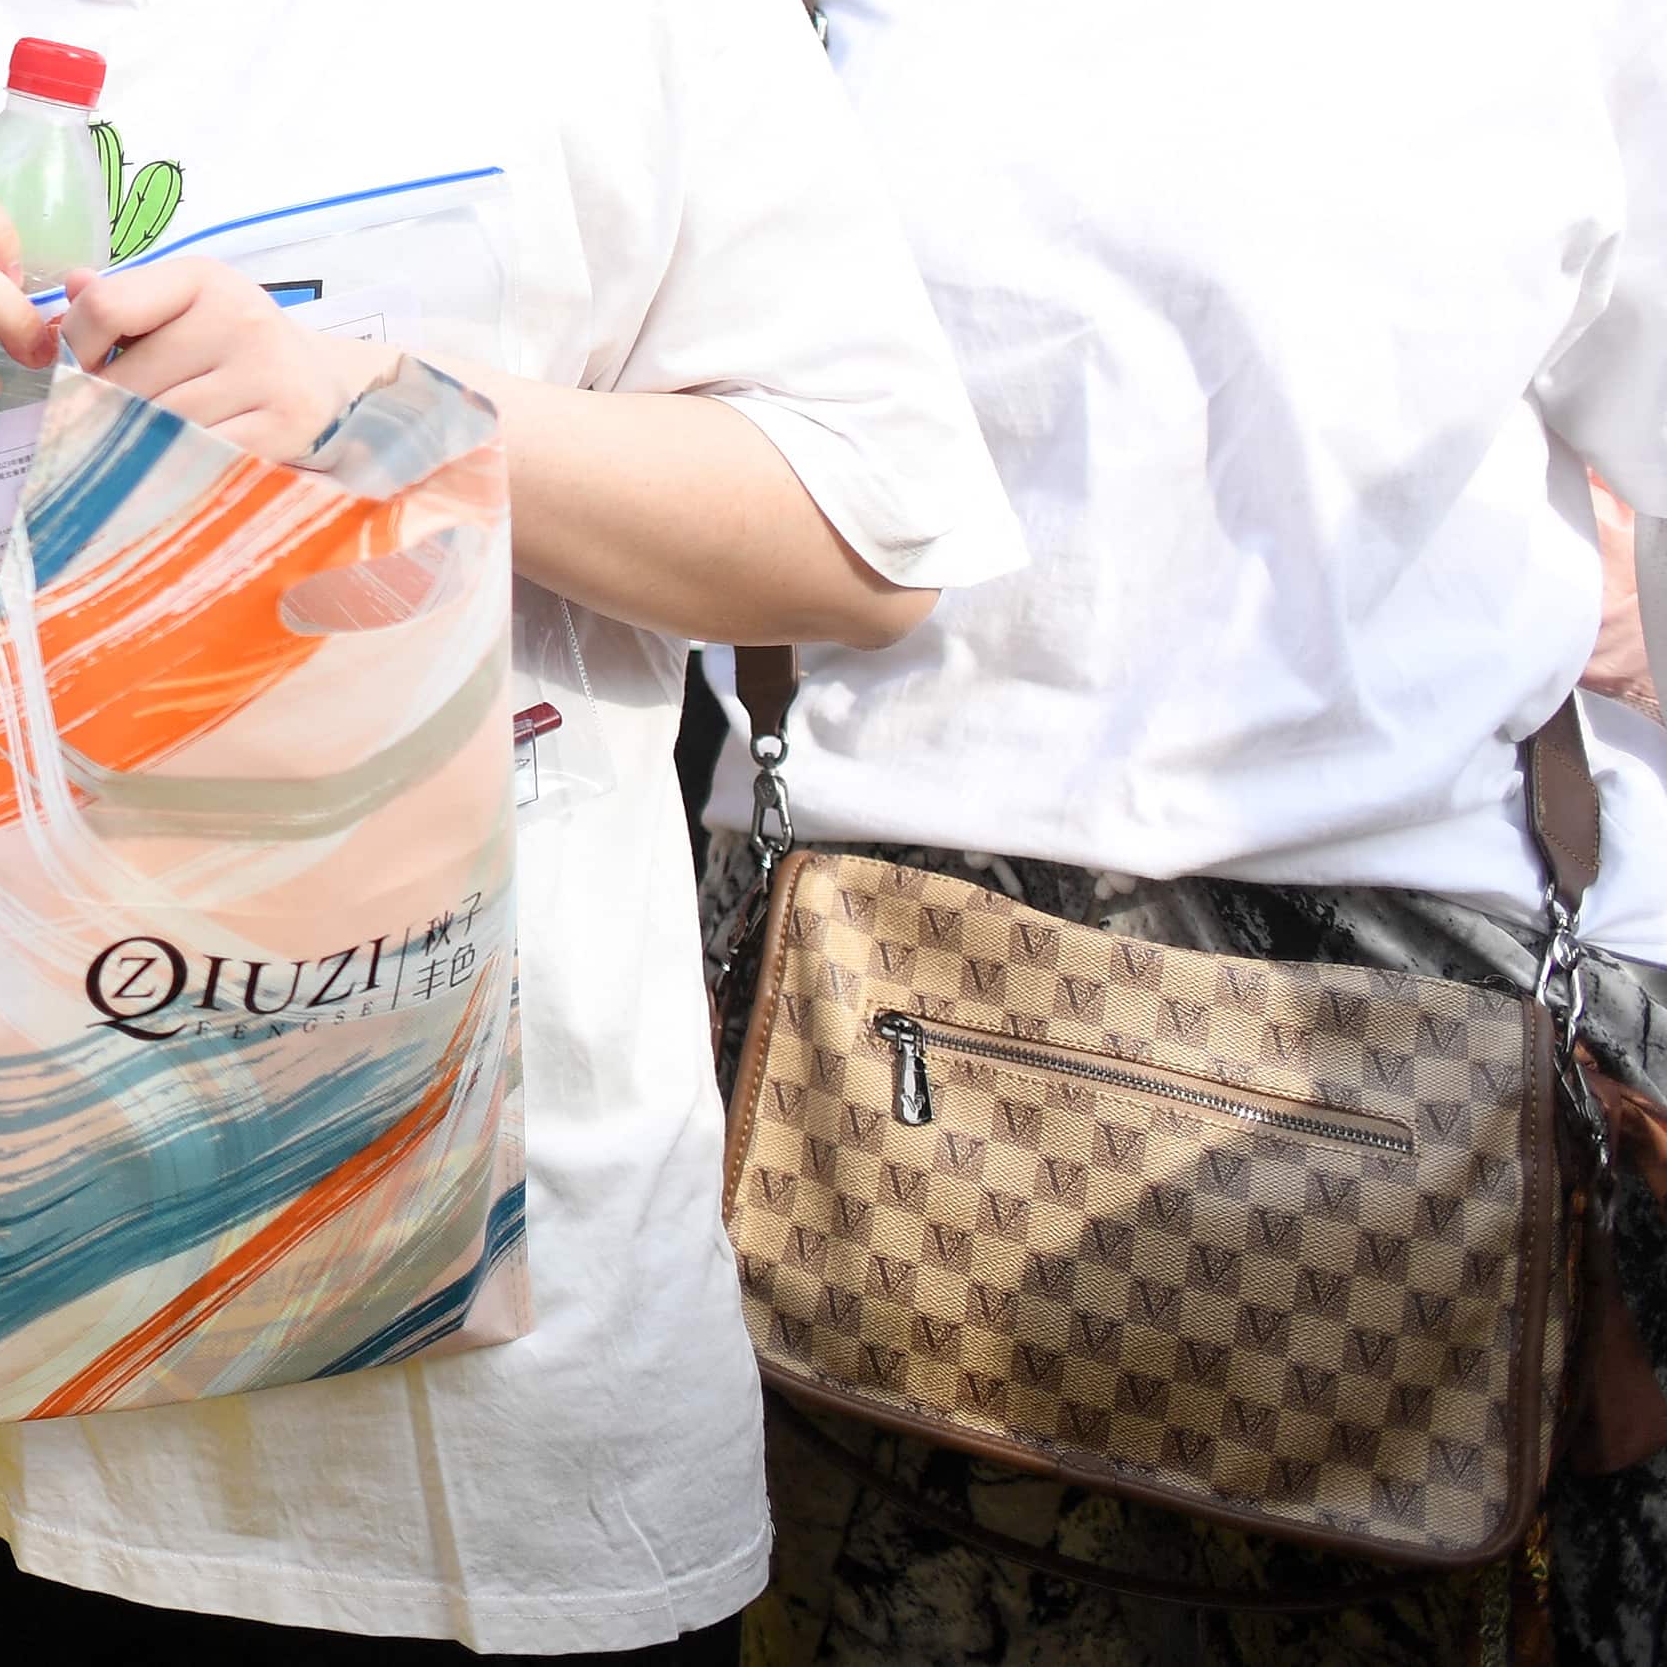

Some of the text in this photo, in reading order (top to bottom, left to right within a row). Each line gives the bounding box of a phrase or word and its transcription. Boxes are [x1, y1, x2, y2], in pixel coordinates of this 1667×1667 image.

[421, 892, 483, 956] 秋子
[85, 935, 389, 1041] QIUZI
[412, 942, 476, 999] 丰色
